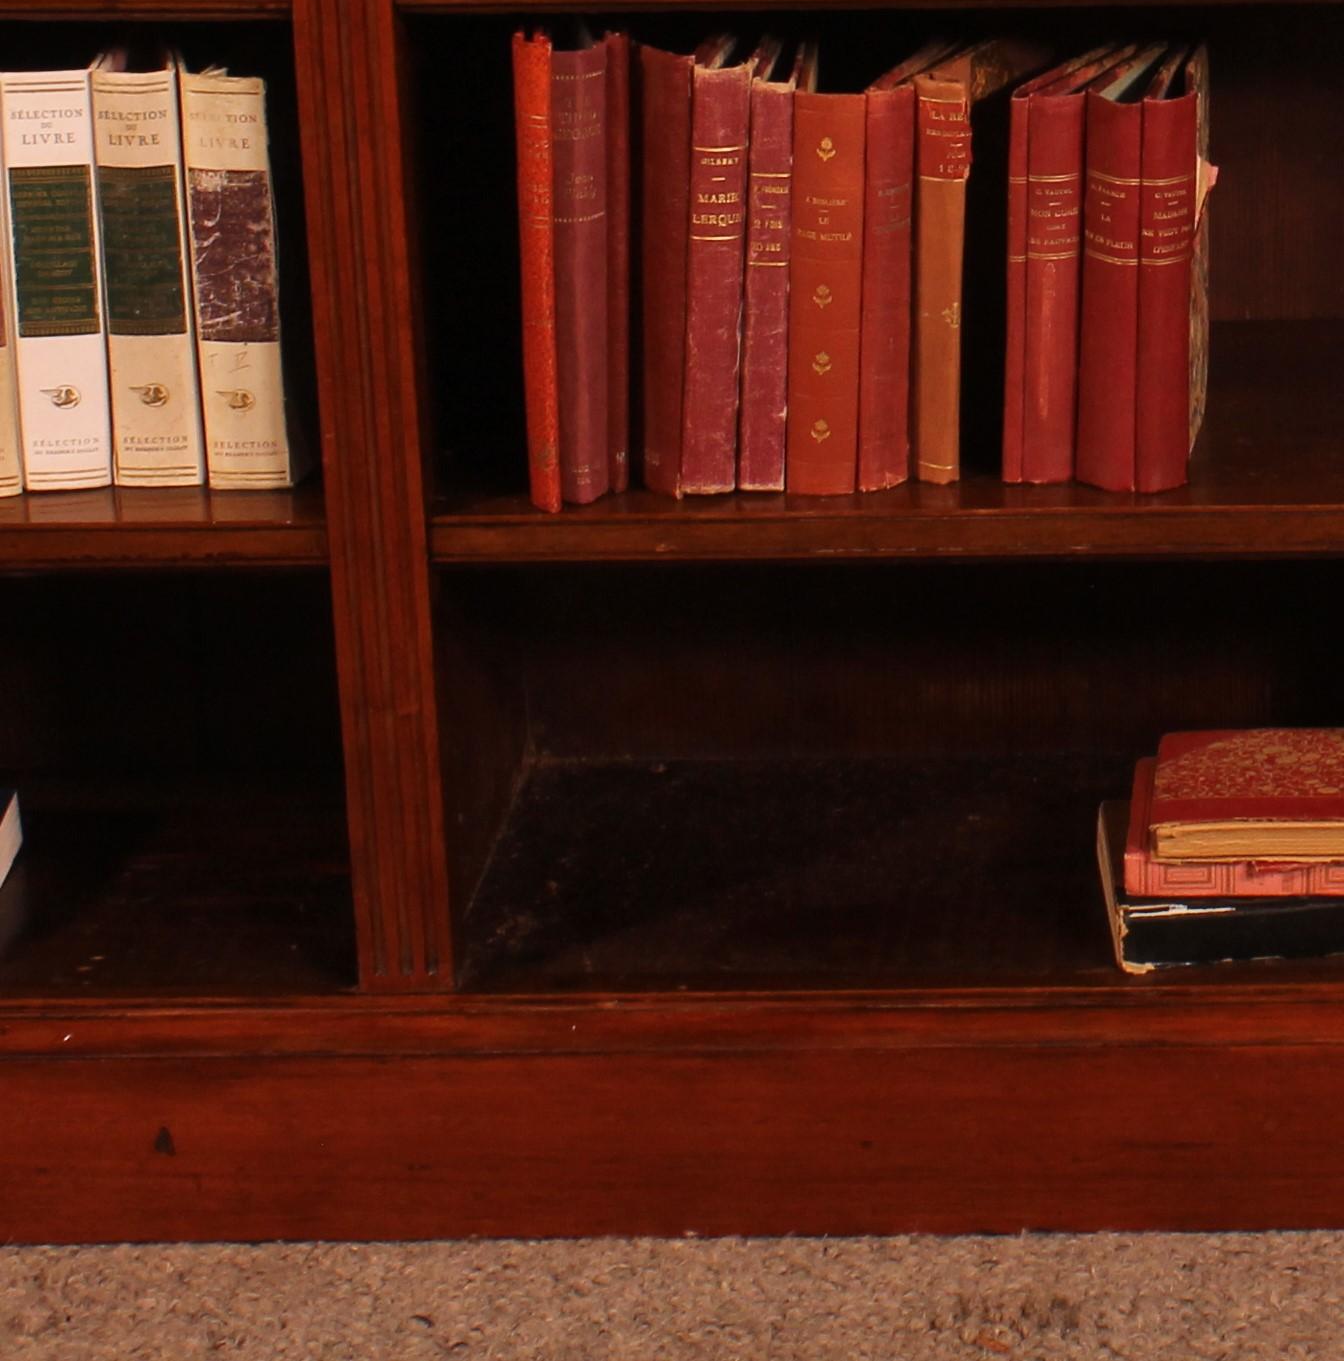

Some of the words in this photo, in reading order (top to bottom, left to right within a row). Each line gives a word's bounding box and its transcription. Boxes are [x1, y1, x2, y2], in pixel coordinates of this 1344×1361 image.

[189, 111, 257, 124] SLTION
[22, 132, 76, 145] LIVRE
[108, 134, 160, 146] LIVRE
[697, 192, 739, 204] MARIE
